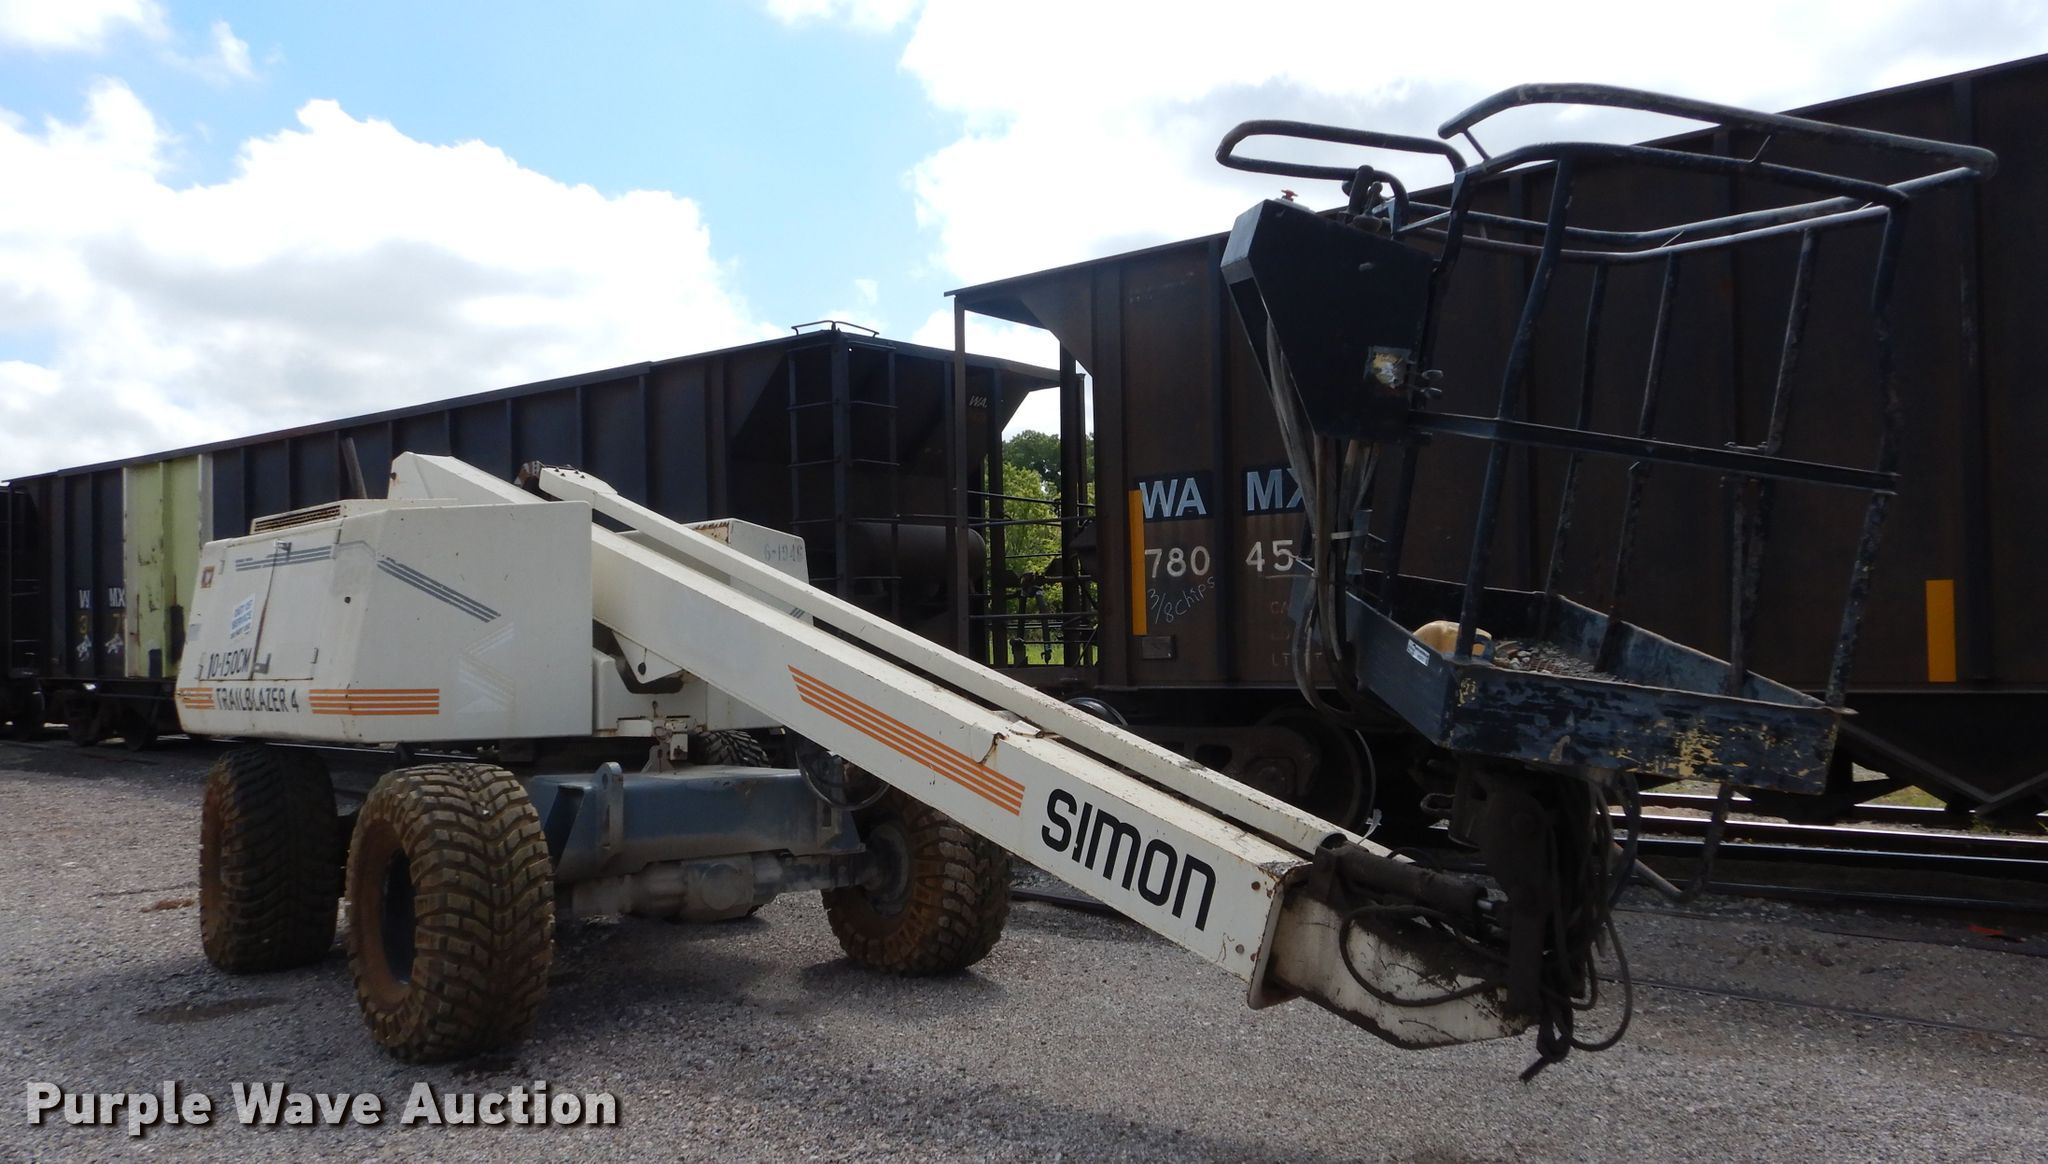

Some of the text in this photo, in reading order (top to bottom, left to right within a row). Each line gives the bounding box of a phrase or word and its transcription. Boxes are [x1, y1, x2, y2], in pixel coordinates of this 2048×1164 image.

[1139, 477, 1207, 519] WA
[1144, 545, 1211, 579] 780
[216, 687, 300, 713] TRAILBLAZER 4
[1041, 788, 1217, 931] SIMON
